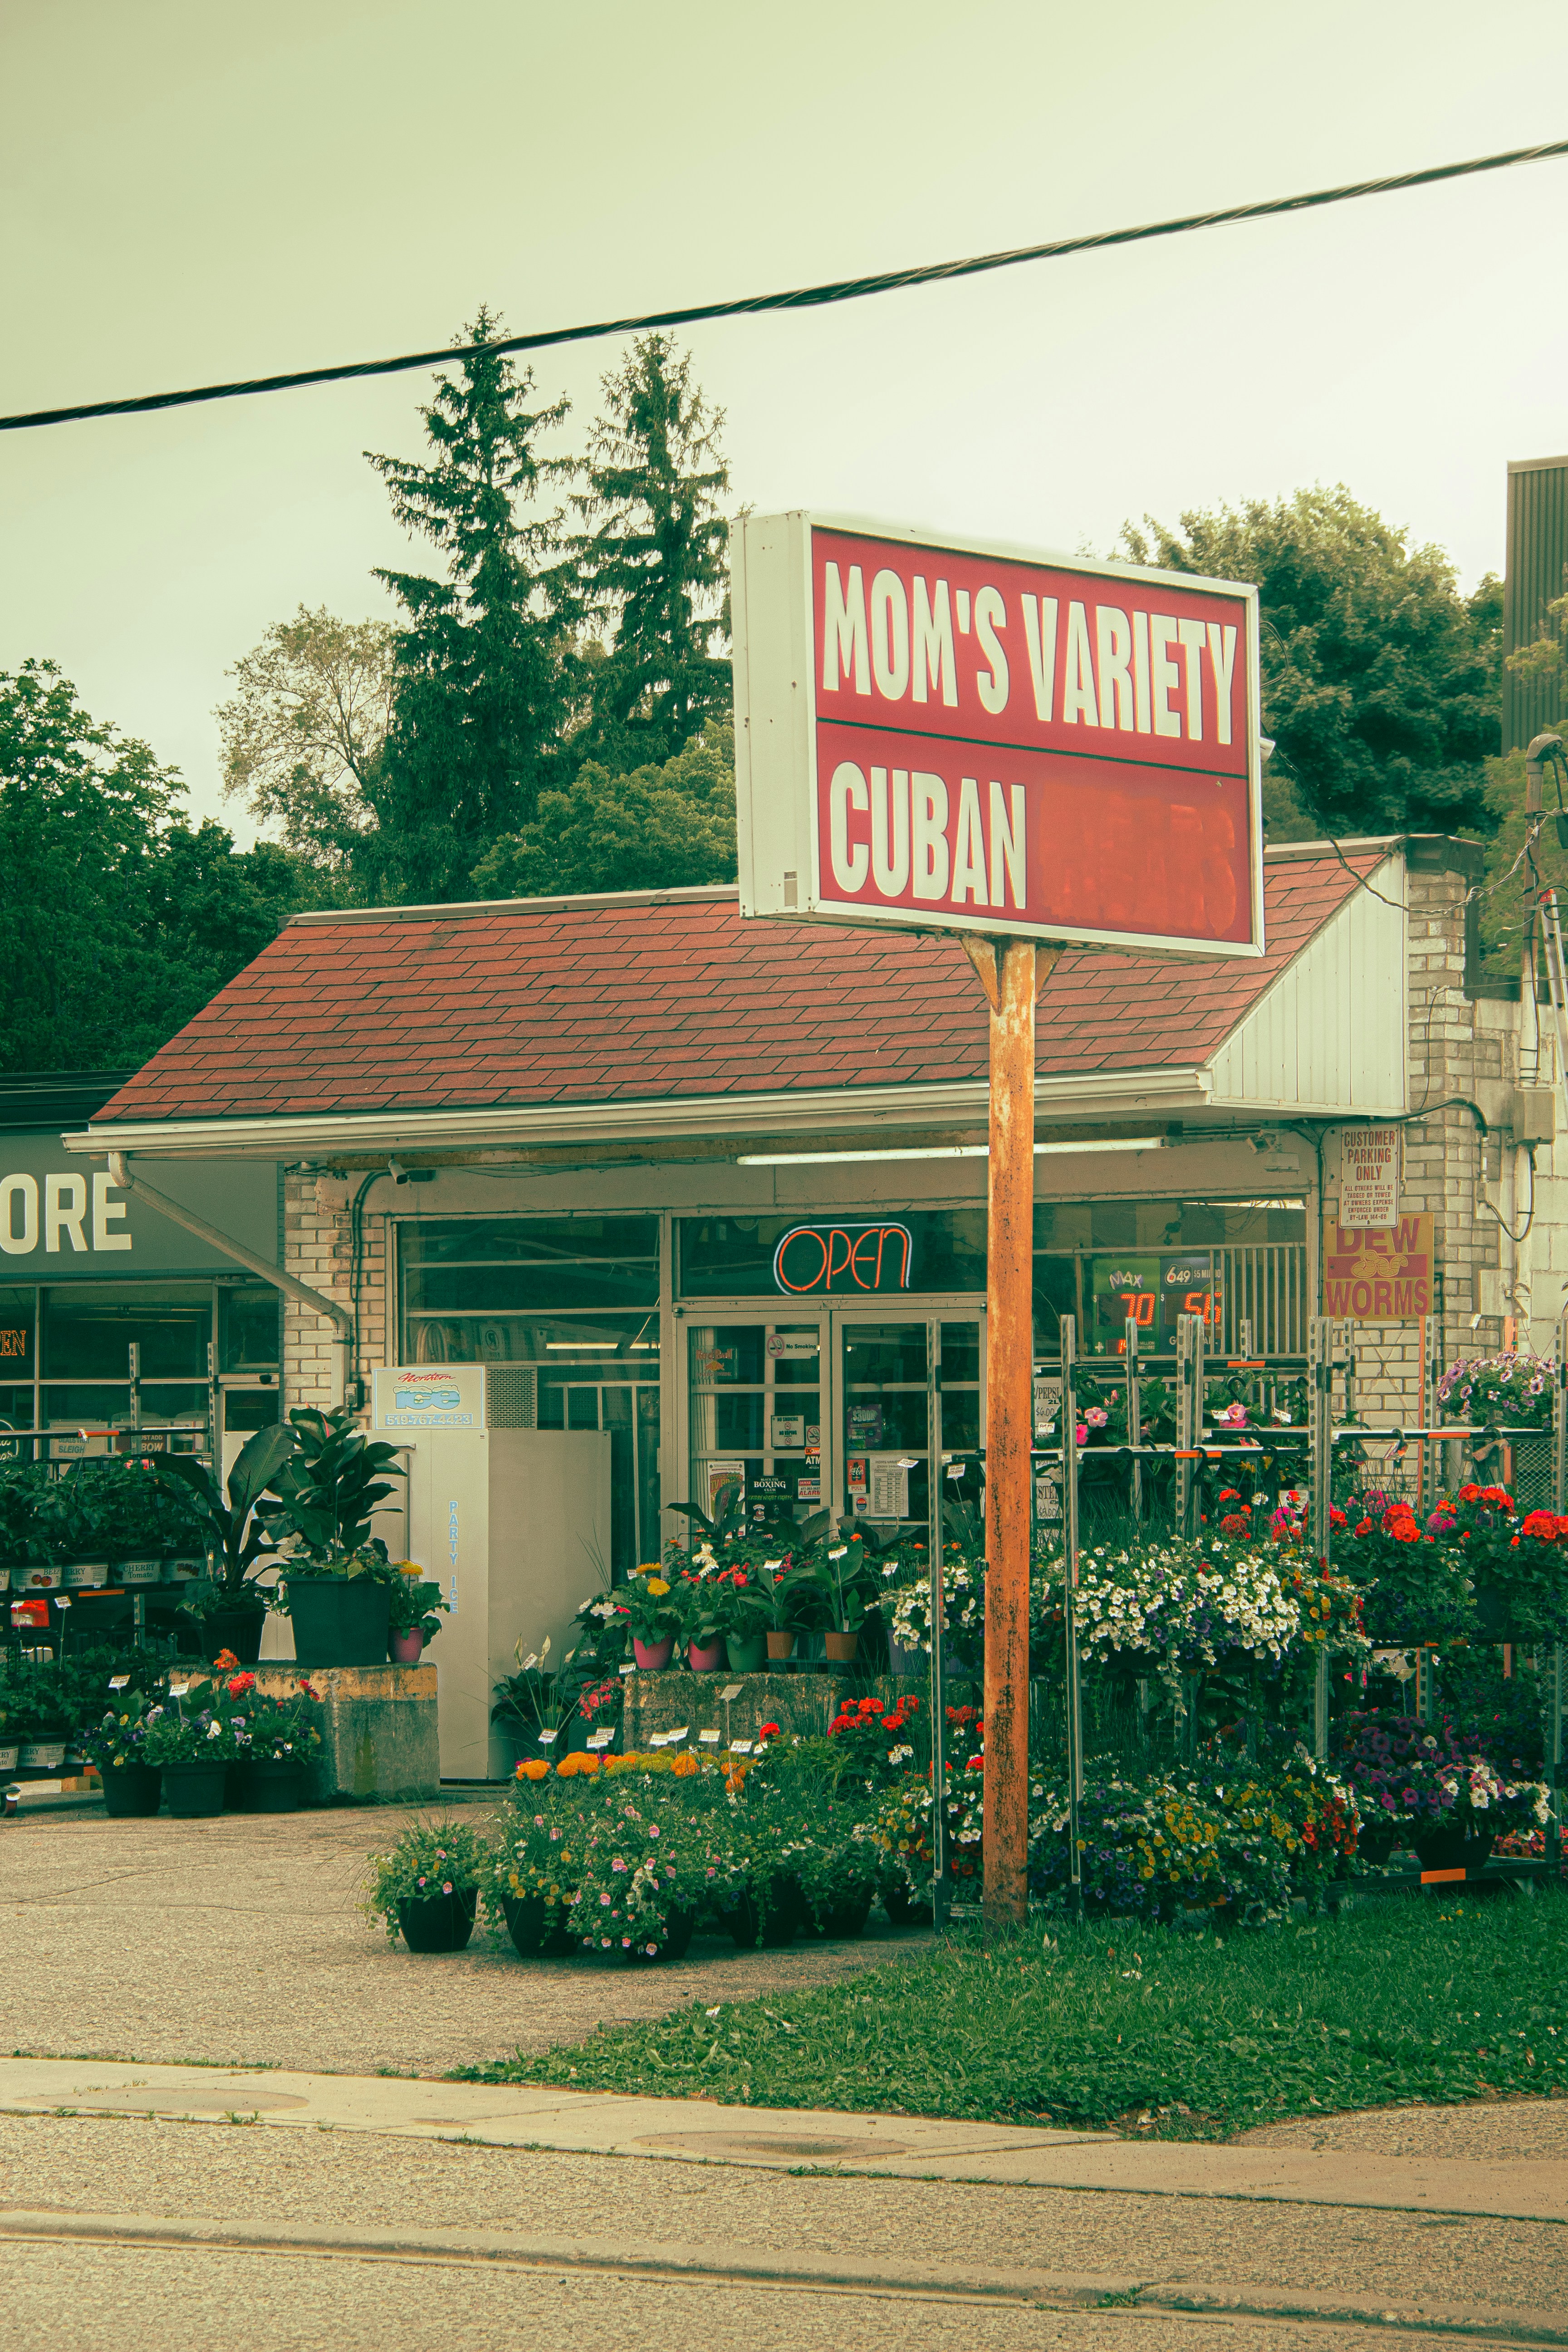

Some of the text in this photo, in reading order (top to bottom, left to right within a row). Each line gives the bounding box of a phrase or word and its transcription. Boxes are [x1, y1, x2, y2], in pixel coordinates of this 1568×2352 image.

[823, 561, 1237, 745] MOM'S VARIETY
[830, 761, 1026, 909] CUBAN
[1344, 1131, 1396, 1147] CUSTOMER
[1348, 1148, 1392, 1164] PARKING
[1357, 1166, 1383, 1181] ONLY
[0, 1172, 132, 1254] ORE
[1336, 1218, 1421, 1254] DEW
[778, 1229, 908, 1291] OPEN
[1109, 1270, 1142, 1290] MAX
[1167, 1267, 1191, 1284] 649
[1201, 1269, 1221, 1278] MILIO
[1325, 1279, 1429, 1316] WORMS
[1121, 1294, 1156, 1325] 70
[0, 1331, 26, 1357] EN
[398, 1372, 456, 1383] Northern
[387, 1415, 471, 1425] 519-767-4423
[1036, 1406, 1055, 1416] $6.00
[59, 1445, 85, 1453] SLEIGH
[805, 1455, 820, 1465] ATM
[449, 1500, 459, 1565] PARTY
[123, 1563, 155, 1572] CHERRY
[449, 1576, 459, 1615] ICE
